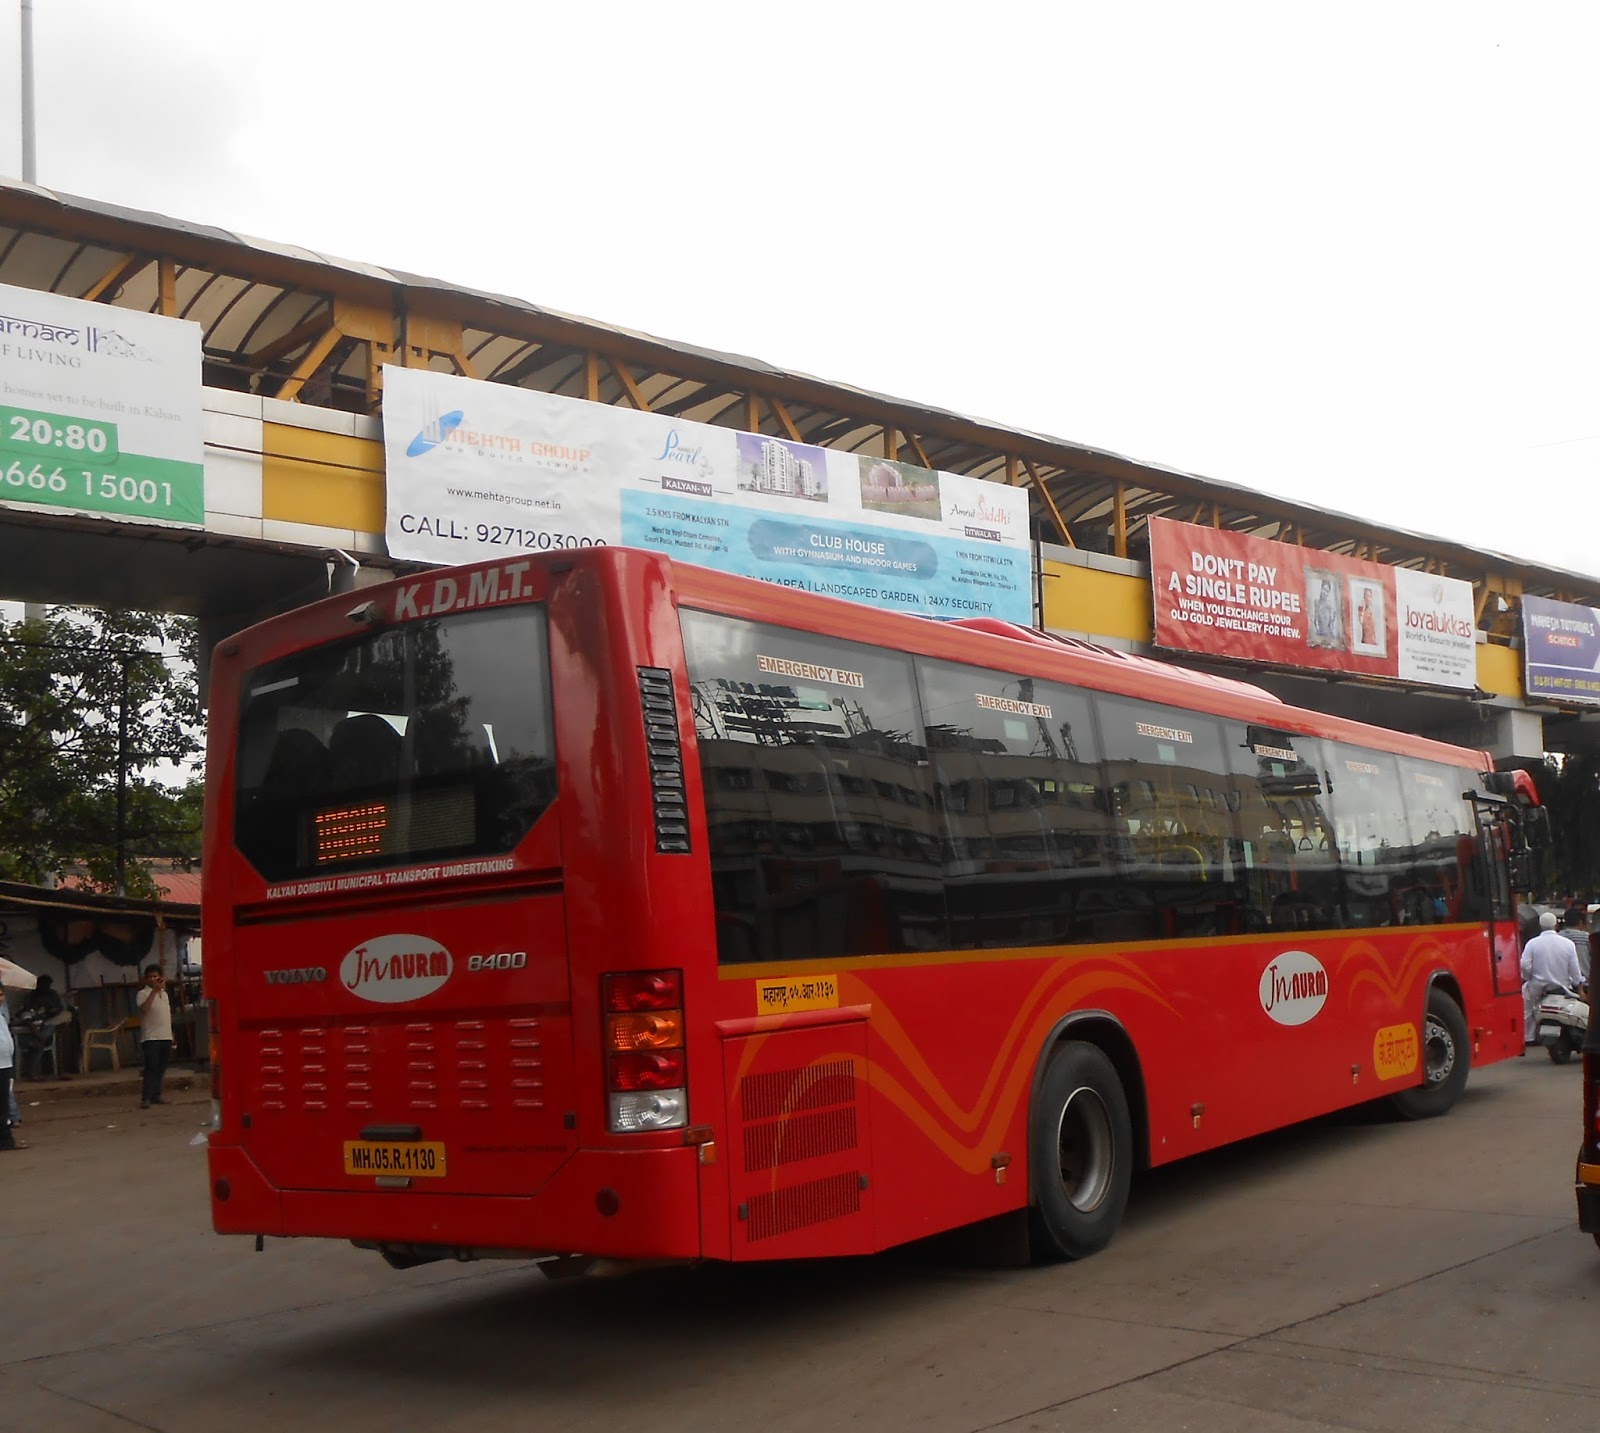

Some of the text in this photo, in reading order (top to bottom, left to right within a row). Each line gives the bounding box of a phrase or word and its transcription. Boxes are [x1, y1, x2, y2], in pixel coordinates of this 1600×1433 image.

[18, 347, 81, 369] LIVING
[4, 383, 183, 423] homes yet to be built in Kalyan
[9, 415, 107, 453] 20:80
[446, 427, 592, 462] MEHTA GROUP
[652, 429, 703, 465] Pearl
[0, 461, 172, 506] 666 15001
[701, 484, 711, 494] W
[447, 487, 561, 510] www.mehtagroup.net.in
[977, 498, 1011, 526] Siddhi
[400, 514, 469, 541] CALL:
[646, 507, 730, 527] 2.5 KMS FROM KALYAN STN
[810, 534, 885, 555] CLUB HOUSE
[965, 527, 992, 539] TITWALA
[774, 546, 918, 572] WITH GYMNASIUM AND INDOOR GAMES
[1191, 551, 1277, 586] DON'T PAY
[394, 561, 533, 621] K.D.M.T.
[814, 582, 878, 600] LANDSCAPED
[881, 590, 920, 604] GARDEN
[928, 596, 950, 607] 24X7
[951, 598, 993, 613] SECURITY
[1168, 571, 1182, 593] A
[1185, 574, 1247, 605] SINGLE
[1250, 587, 1301, 613] RUPEE
[1170, 609, 1301, 639] OLD GOLD JEWELLERY FOR NEW.
[1178, 597, 1291, 626] WHEN YOU EXCHANGE YOUR
[1405, 604, 1472, 638] Joyalukkas
[1405, 631, 1427, 642] World's
[1548, 634, 1577, 647] SCIENCE
[758, 656, 863, 687] EMERGENCY EXIT
[976, 694, 1052, 718] EMERGENCY EXIT
[1137, 722, 1193, 743] EMERGENCY EXIT
[1254, 744, 1298, 761] EMERGENCY EXIT
[266, 858, 514, 899] KALYAN DOMBIVLI MUNICIPAL TRANSPORT UNDERTAKING
[467, 952, 527, 971] 8400
[263, 967, 327, 985] VOLVO
[352, 1147, 436, 1171] MH.05.R.1130
